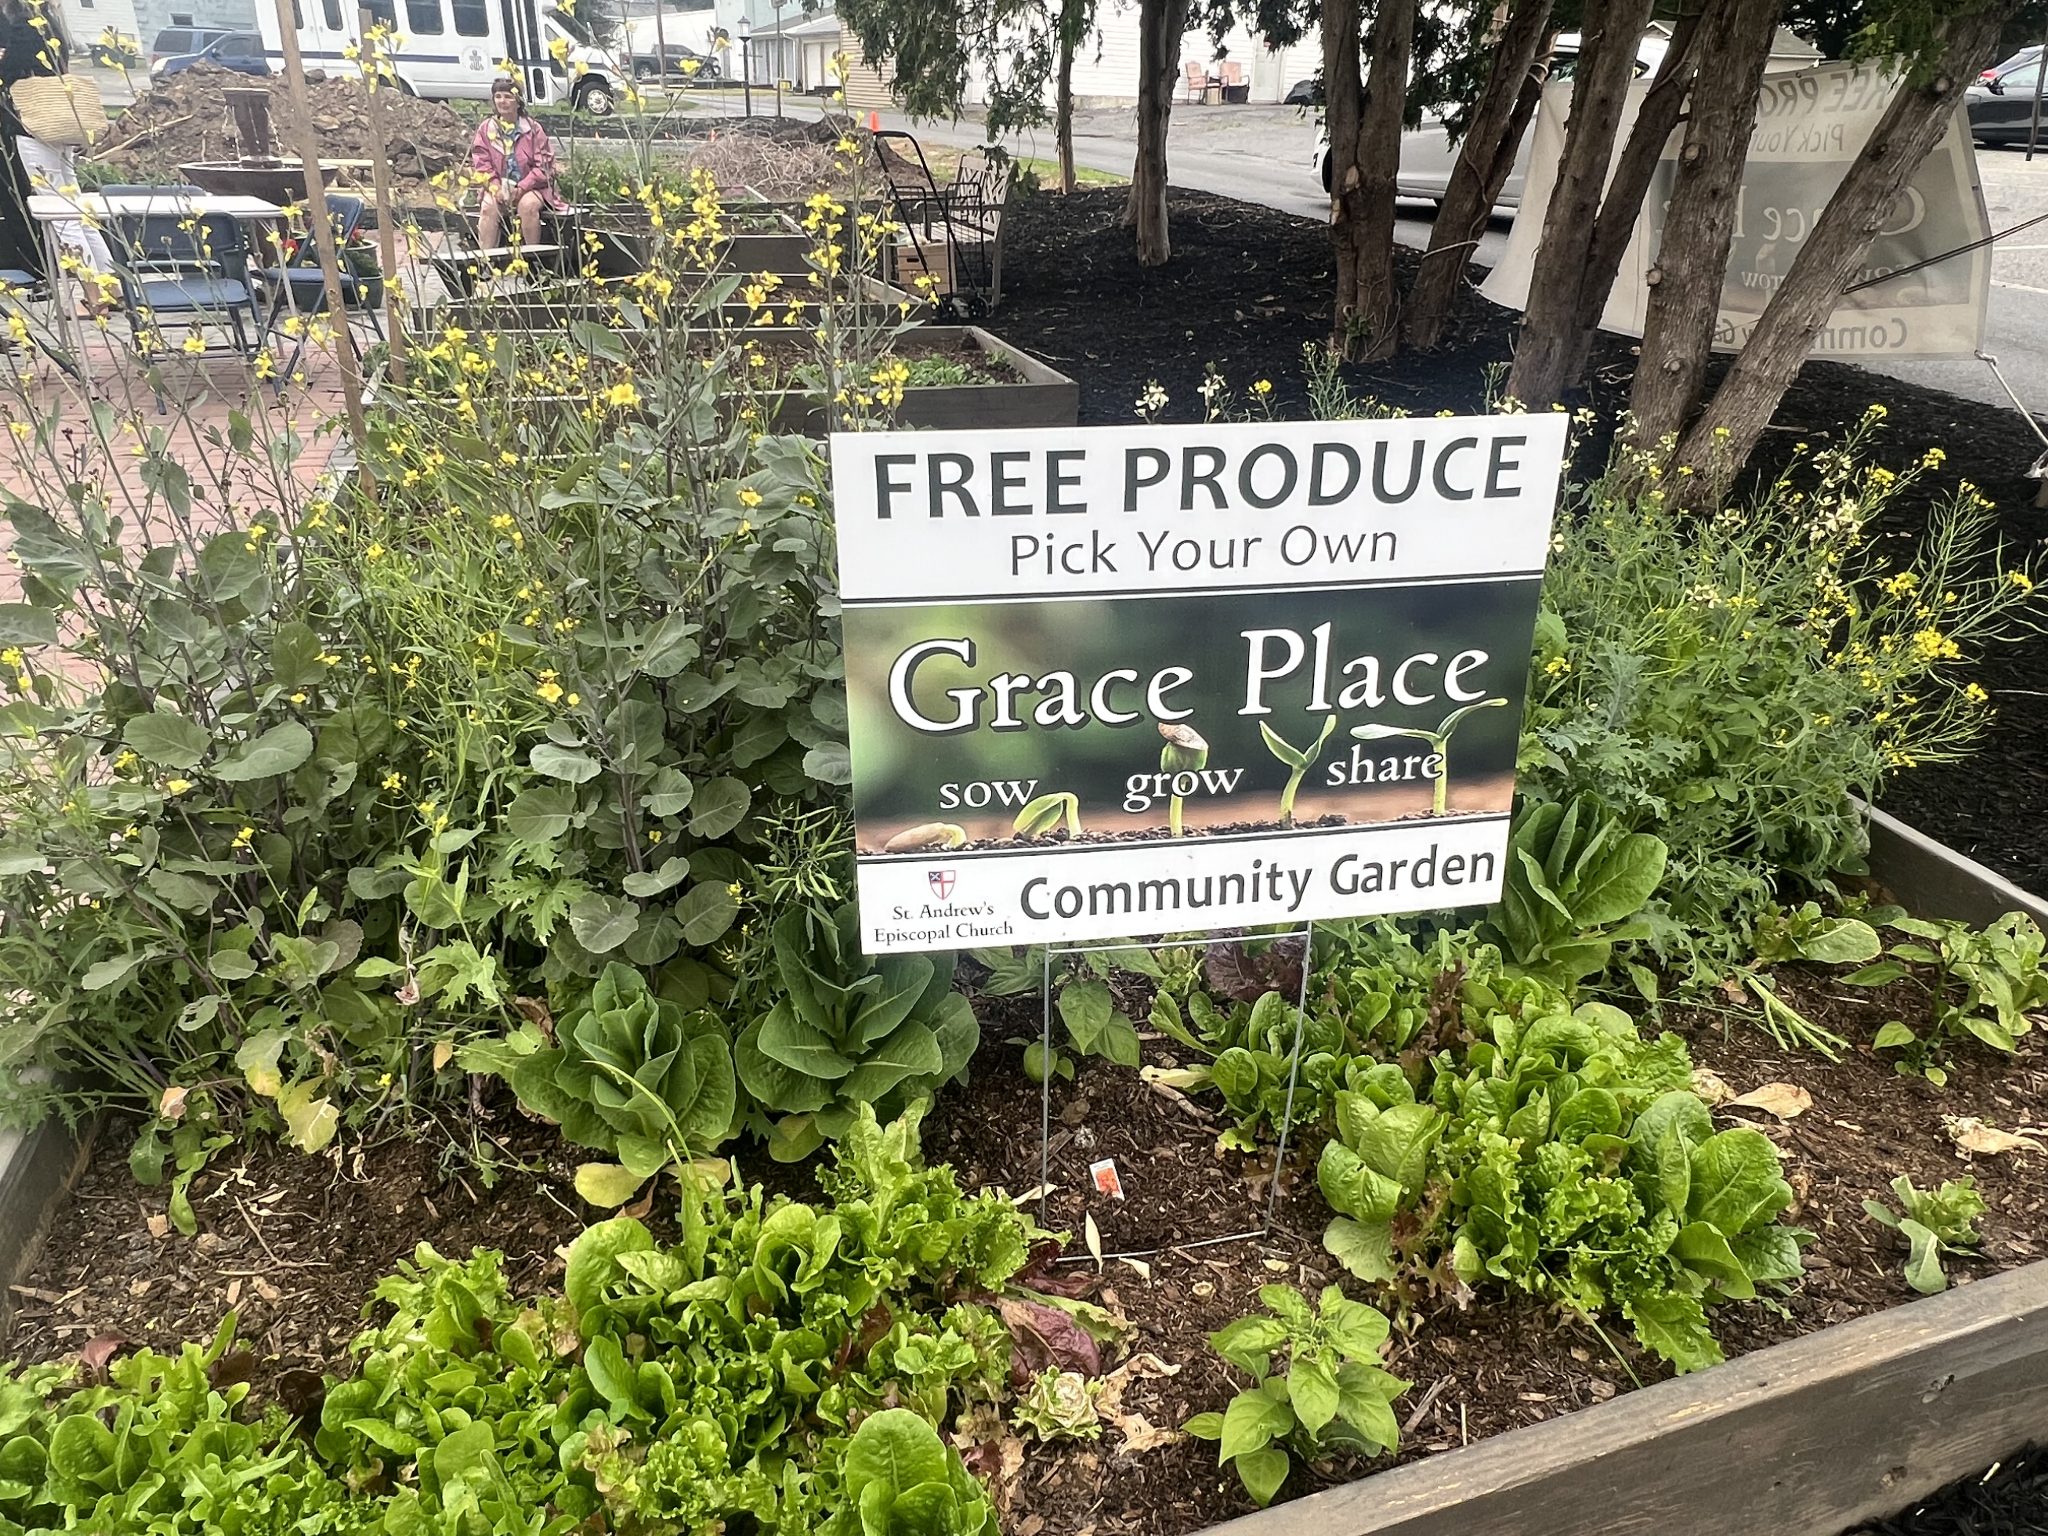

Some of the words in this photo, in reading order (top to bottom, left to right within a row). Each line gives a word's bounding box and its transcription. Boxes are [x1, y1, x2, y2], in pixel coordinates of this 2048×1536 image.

[874, 449, 1088, 519] FREE
[1123, 435, 1528, 513] PRODUCE
[1011, 529, 1118, 576] Pick
[1137, 530, 1262, 572] Your
[1280, 525, 1397, 567] Own
[888, 637, 1196, 735] Grace
[1237, 621, 1490, 716] Place
[938, 779, 1039, 810] sow
[1122, 767, 1245, 813] grow
[1326, 743, 1444, 787] share
[892, 905, 914, 920] St.
[919, 901, 995, 919] Andrew's
[1020, 858, 1313, 920] Community
[1329, 843, 1495, 897] Garden
[874, 924, 950, 946] Episcopal
[956, 921, 1013, 938] Church
